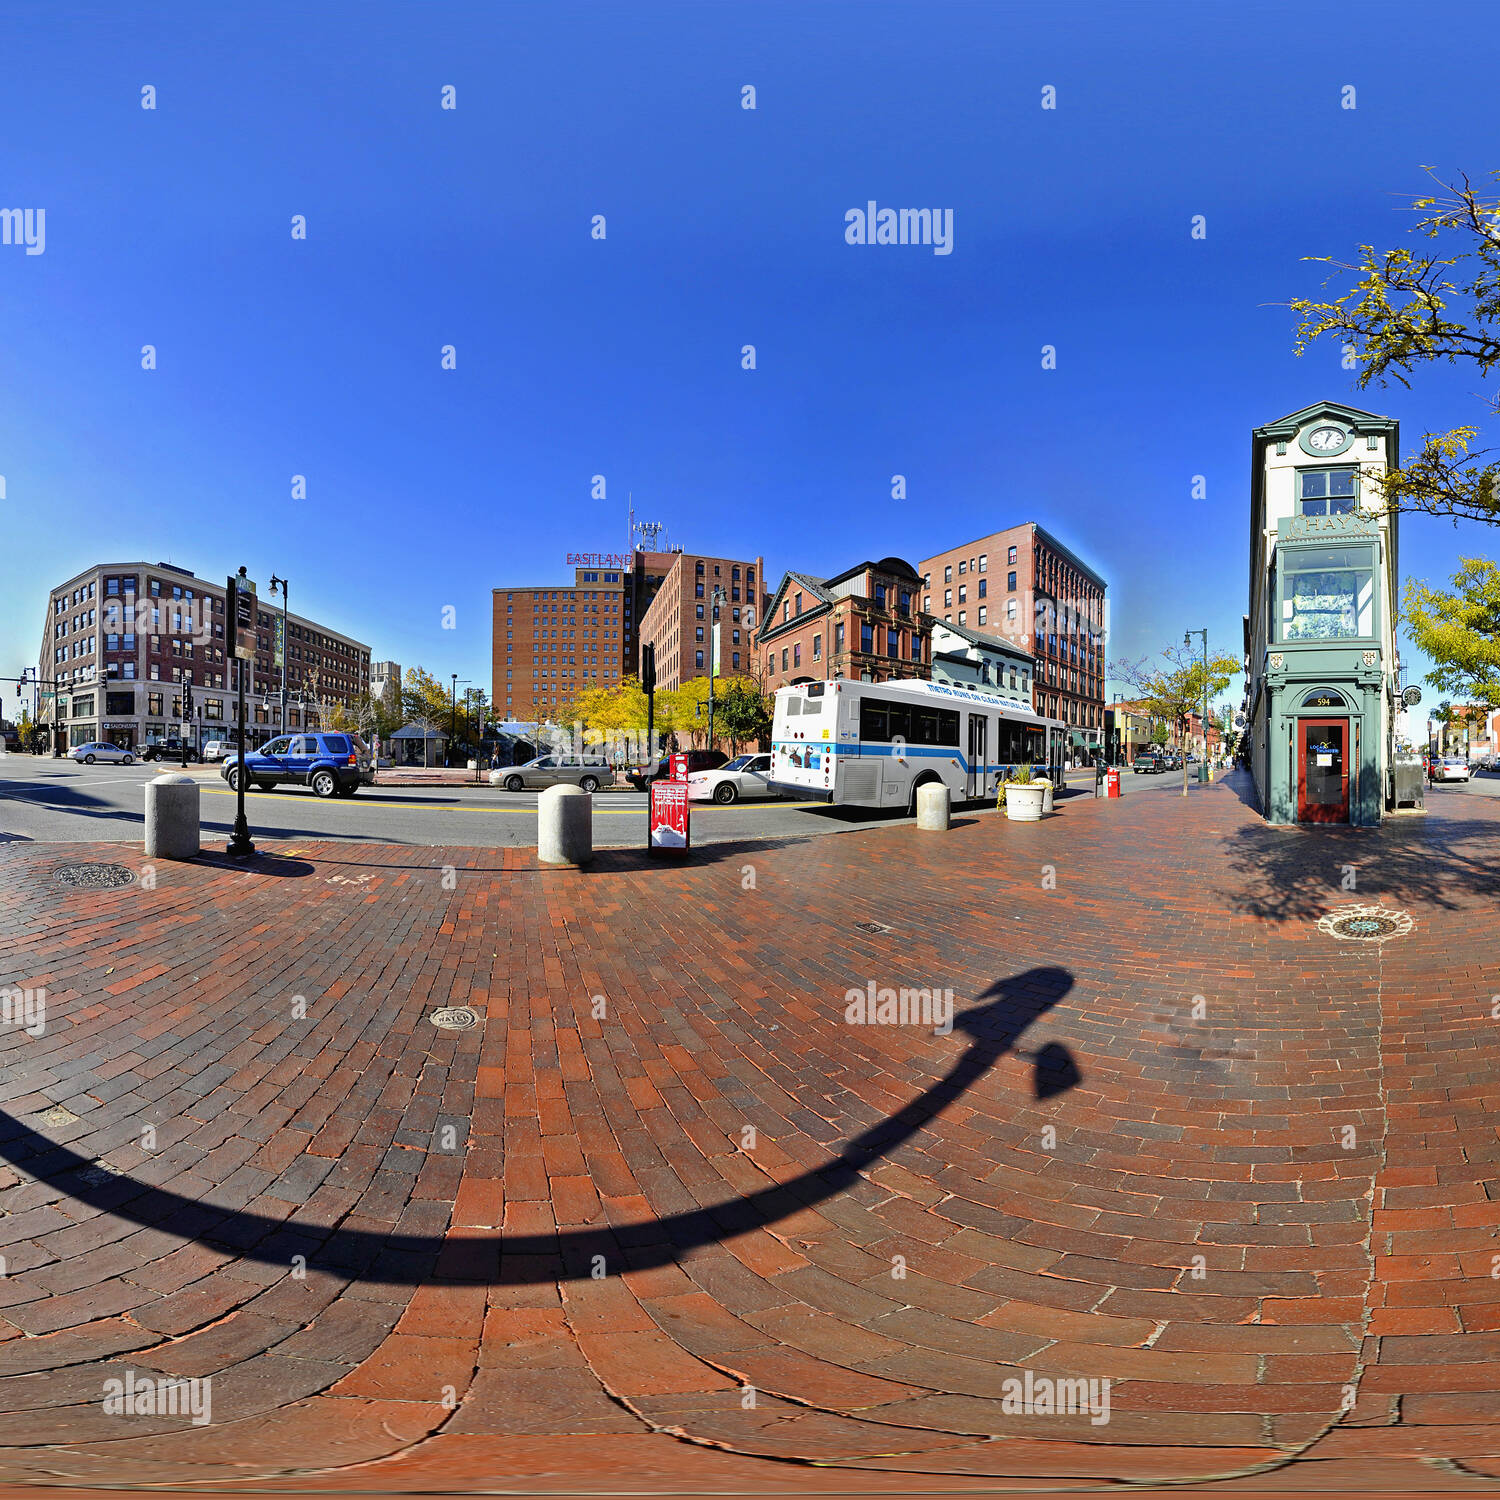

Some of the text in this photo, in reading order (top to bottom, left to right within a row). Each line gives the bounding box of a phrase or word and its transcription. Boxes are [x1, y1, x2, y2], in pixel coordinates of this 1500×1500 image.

[1306, 517, 1350, 531] HAY
[567, 553, 633, 565] EASTLAND
[1317, 698, 1330, 706] 594
